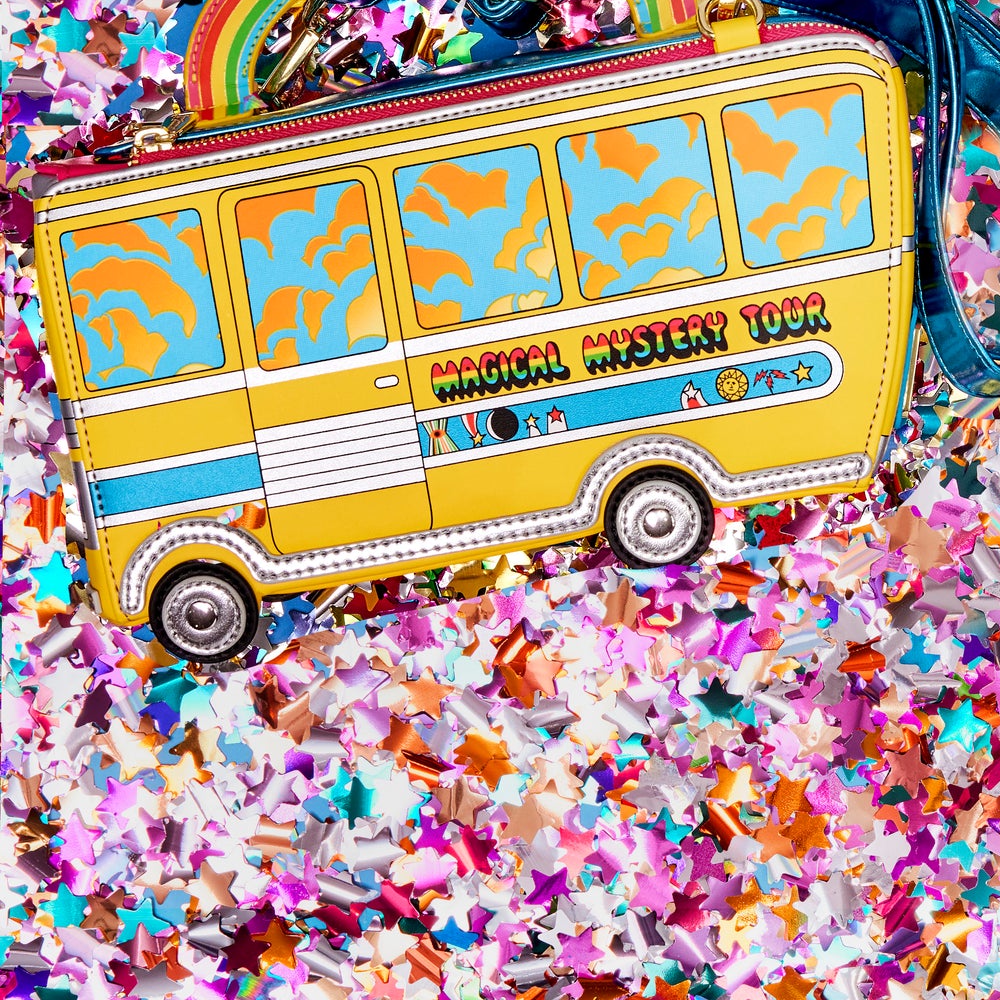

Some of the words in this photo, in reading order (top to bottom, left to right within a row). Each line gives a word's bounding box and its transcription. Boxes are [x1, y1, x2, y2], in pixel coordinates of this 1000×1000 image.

[430, 341, 571, 404] MAGICAL
[582, 310, 728, 376] MYSTERY
[740, 292, 832, 345] TOUR
